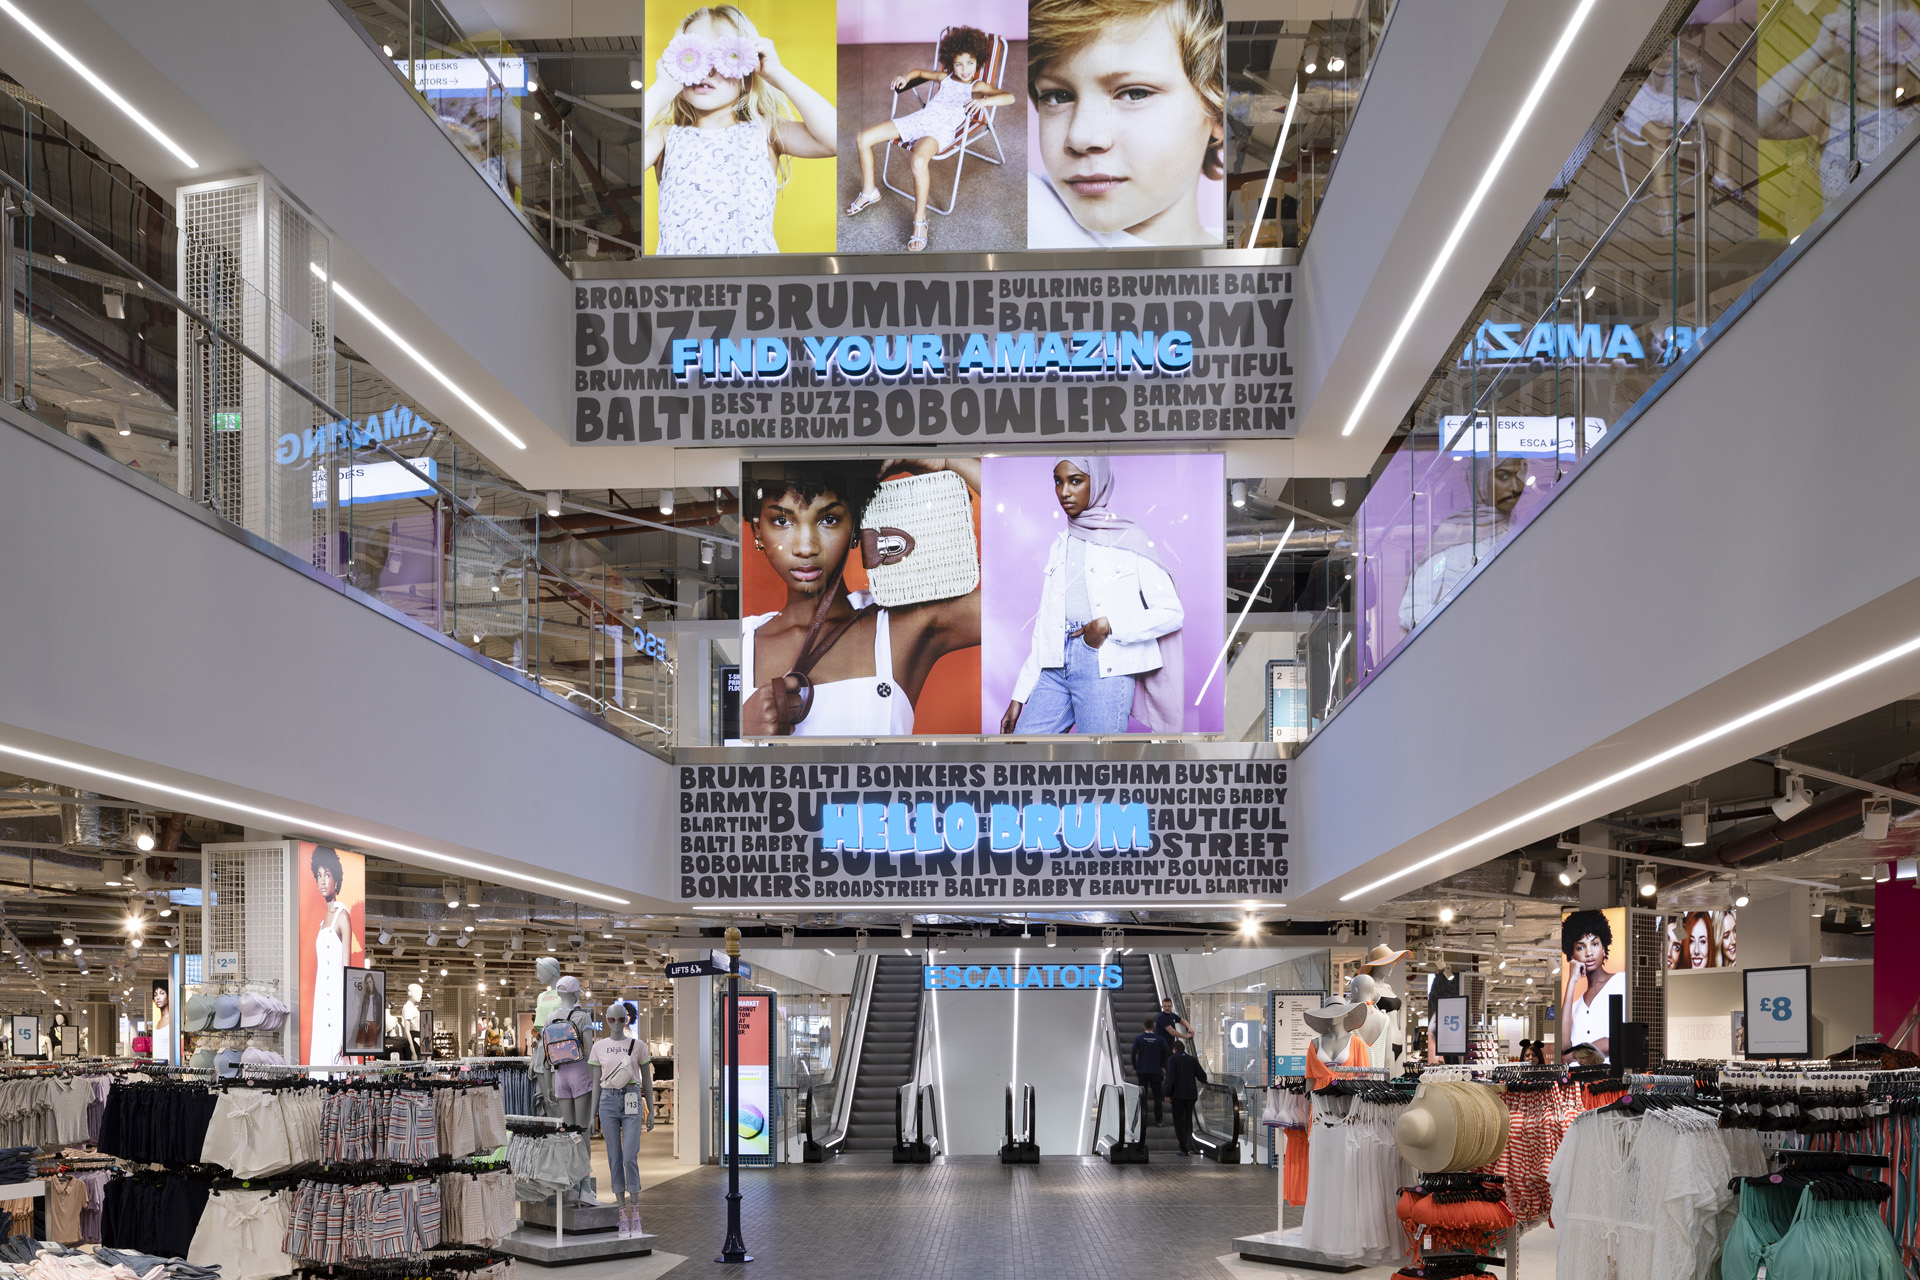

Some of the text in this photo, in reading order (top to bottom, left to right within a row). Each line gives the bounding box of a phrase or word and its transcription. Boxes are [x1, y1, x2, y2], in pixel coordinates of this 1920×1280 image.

[575, 284, 742, 310] BROADSTREET
[1000, 272, 1292, 299] BULLRING BRUMMIE BALTI
[746, 279, 994, 331] BRUMMIE
[999, 300, 1104, 332] BALTI
[1111, 298, 1293, 348] BARMY
[672, 337, 789, 377] FIND
[803, 334, 946, 376] YOUR
[958, 330, 1193, 373] AMAZ!NG
[575, 368, 689, 391] BRUMMI
[712, 391, 850, 415] BEST BUZZ
[1134, 382, 1293, 407] BARMY BUZZ
[575, 395, 706, 442] BALTI
[853, 386, 1128, 438] BOBOWLER
[1134, 406, 1296, 433] BLABBERIN'
[712, 417, 848, 439] BLOKE BRUM
[1276, 672, 1283, 680] 2
[680, 763, 1287, 789] BRUM BALTI BONKERS BIRMINGHAM BUSTLING
[680, 790, 768, 813] BARMY
[1119, 787, 1287, 806] BOUNCING BABBY
[680, 816, 768, 833] BLARTIN'
[822, 802, 1150, 852] HELLO BRUM
[1149, 808, 1287, 831] EAUTIFUL
[680, 835, 808, 853] BALTI BABBY
[680, 854, 809, 874] BOBOWLER
[1052, 859, 1289, 877] BLABBERIN' BOUNCING
[680, 874, 811, 898] BONKERS
[814, 878, 1288, 898] BROADSTREET BALTI BABBY BEAUTIFUL BLARTIN'
[217, 958, 237, 968] £2.50
[671, 966, 689, 974] LIFTS
[354, 981, 363, 992] £6
[924, 965, 1123, 989] ESCALATORS
[1278, 1001, 1284, 1009] 2
[1760, 996, 1793, 1022] £8
[18, 1028, 32, 1040] £5
[1278, 1019, 1283, 1027] 1
[1443, 1015, 1460, 1032] £5
[1278, 1057, 1284, 1065] 0
[626, 1101, 638, 1109] £13
